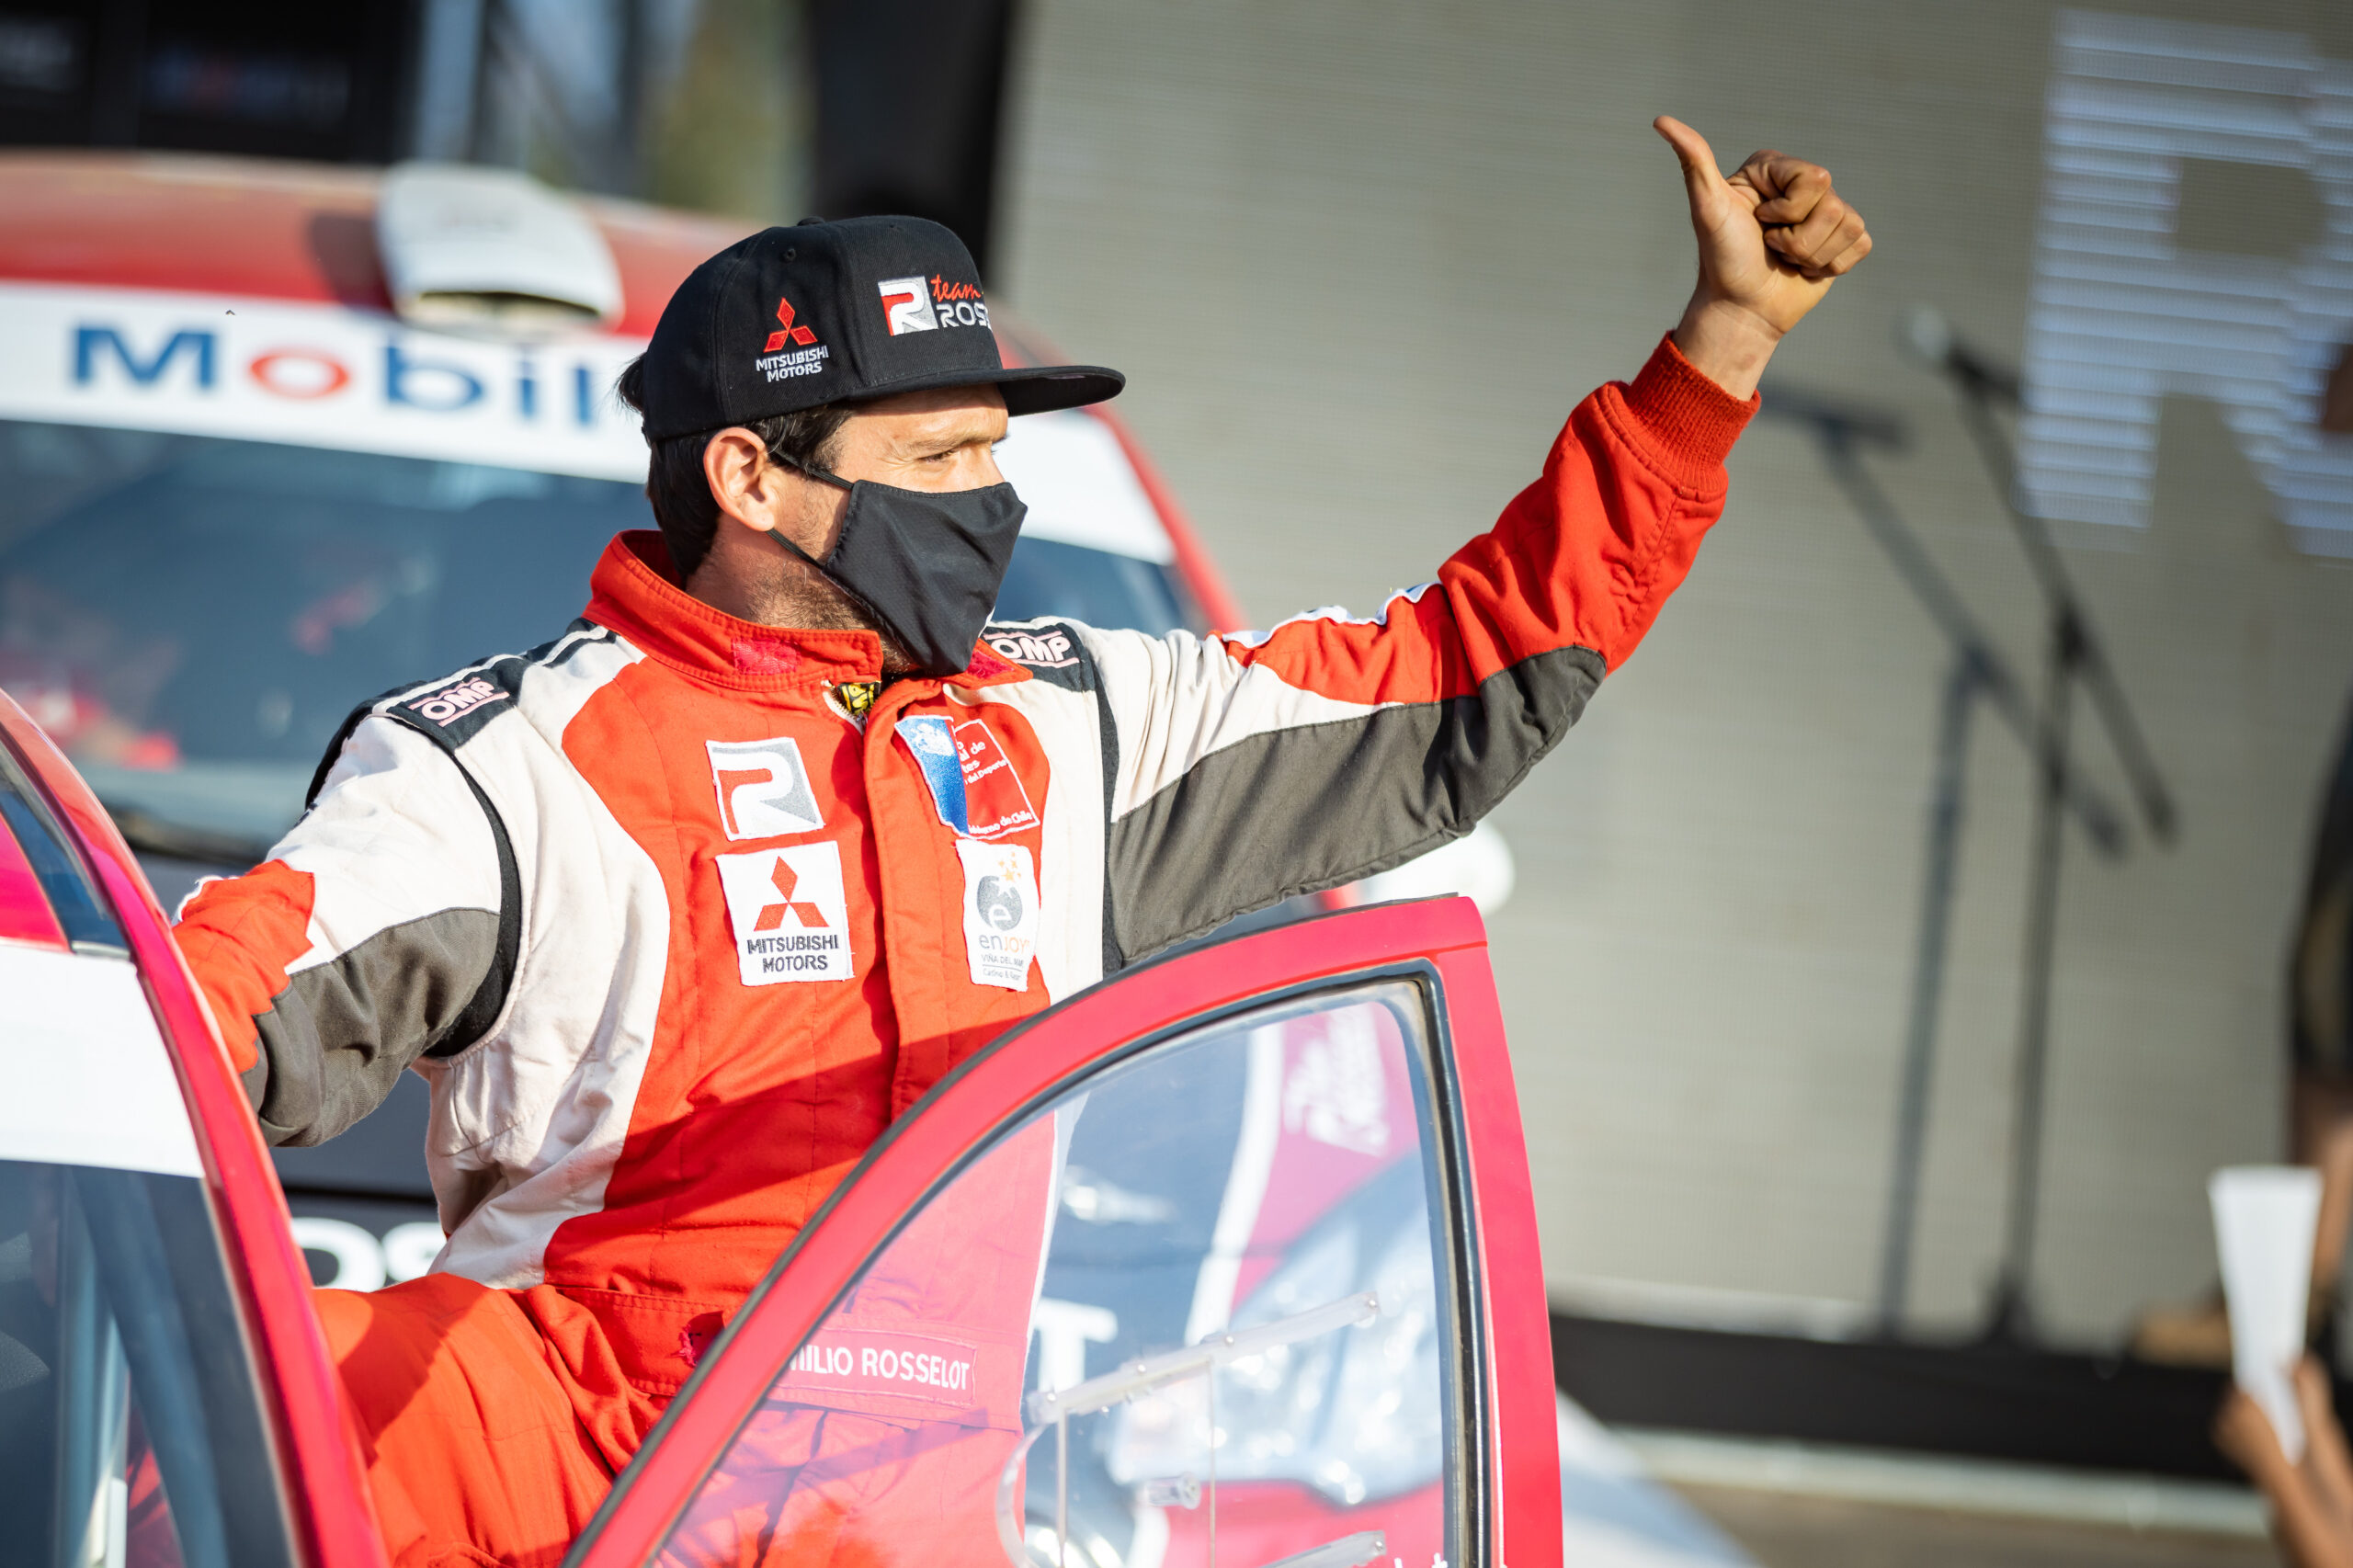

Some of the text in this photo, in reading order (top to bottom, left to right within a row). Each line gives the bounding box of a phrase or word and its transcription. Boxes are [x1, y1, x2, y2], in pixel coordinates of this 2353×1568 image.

[930, 274, 982, 302] team
[936, 301, 993, 332] ROS
[756, 345, 829, 372] MITSUBISHI
[767, 361, 823, 382] MOTORS
[71, 323, 597, 430] Mobil
[991, 636, 1071, 662] OMP
[421, 680, 495, 721] OMP
[746, 934, 840, 955] MITSUBISHI
[762, 954, 828, 973] MOTORS
[861, 1347, 970, 1391] ROSSELOT
